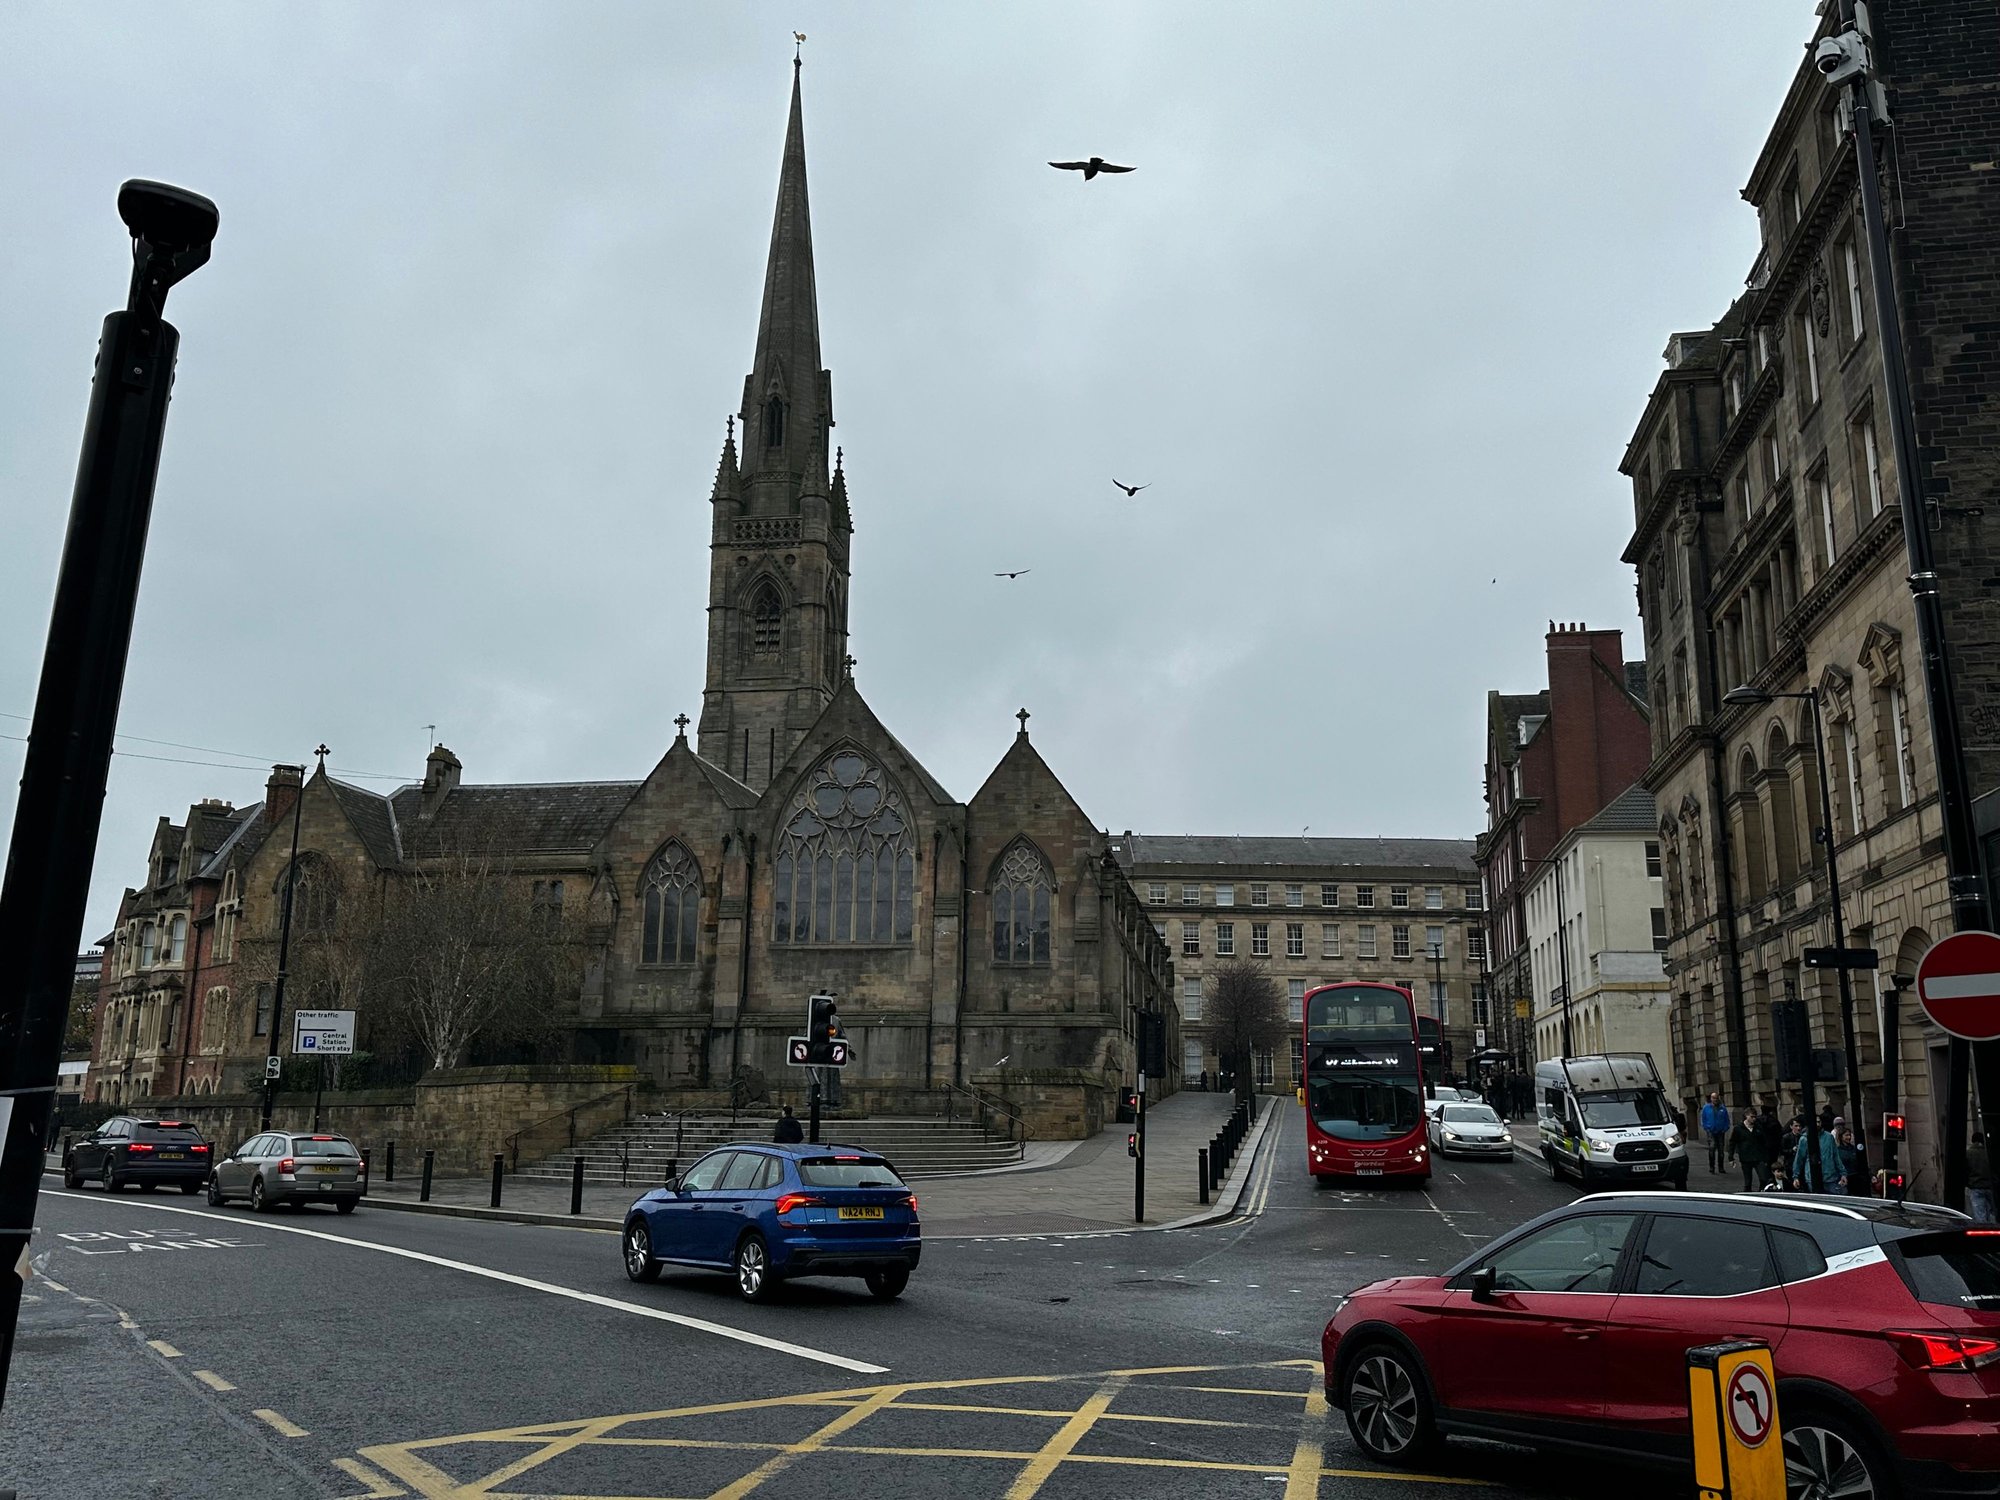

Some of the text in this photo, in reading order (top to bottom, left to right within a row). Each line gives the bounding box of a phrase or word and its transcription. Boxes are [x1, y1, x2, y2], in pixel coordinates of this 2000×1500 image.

[305, 1037, 315, 1047] P
[1617, 1131, 1656, 1139] POLICE
[842, 1207, 881, 1217] NA24 RNJ
[57, 1229, 198, 1242] BUS
[66, 1238, 266, 1254] LANE
